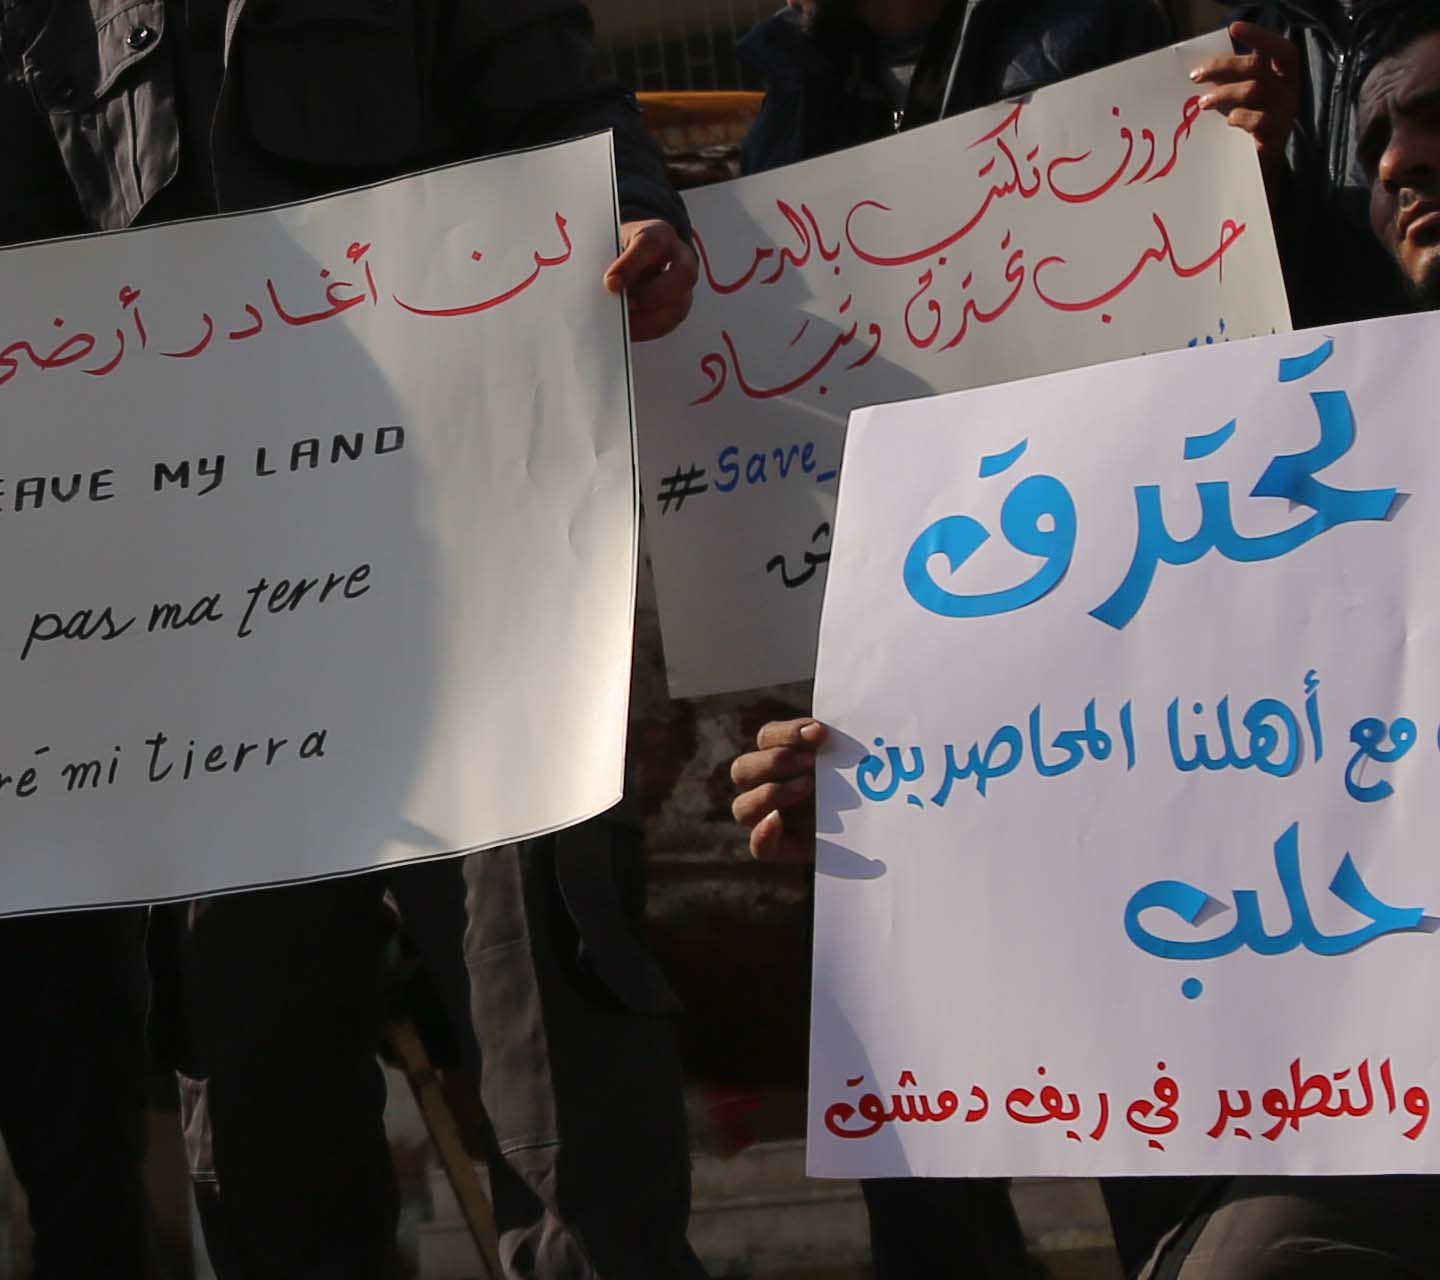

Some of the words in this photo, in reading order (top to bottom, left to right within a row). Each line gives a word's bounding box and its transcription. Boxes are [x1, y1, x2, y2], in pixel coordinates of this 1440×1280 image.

[845, 99, 1042, 267] تكتب
[1048, 94, 1201, 203] حروف
[160, 240, 377, 359] أغادر
[393, 211, 574, 318] لن
[689, 198, 842, 294] بالدما
[904, 228, 1026, 353] تحترق
[1033, 211, 1247, 323] حلب
[153, 455, 226, 496] MY
[256, 425, 405, 477] LAND
[901, 339, 1398, 631] تحترق
[21, 606, 136, 660] pas
[147, 592, 223, 632] ma
[237, 563, 372, 639] terre
[62, 746, 122, 791] mi
[145, 729, 327, 783] tierra
[856, 696, 1138, 808] المحاصرين
[1167, 668, 1324, 778] أهلنا
[1344, 717, 1418, 803] مع
[1123, 821, 1425, 1000] حلب
[823, 1069, 990, 1140] دمشق
[1004, 1065, 1110, 1143] ريف
[1126, 1061, 1180, 1151] في
[1207, 1055, 1431, 1141] والتطوير
